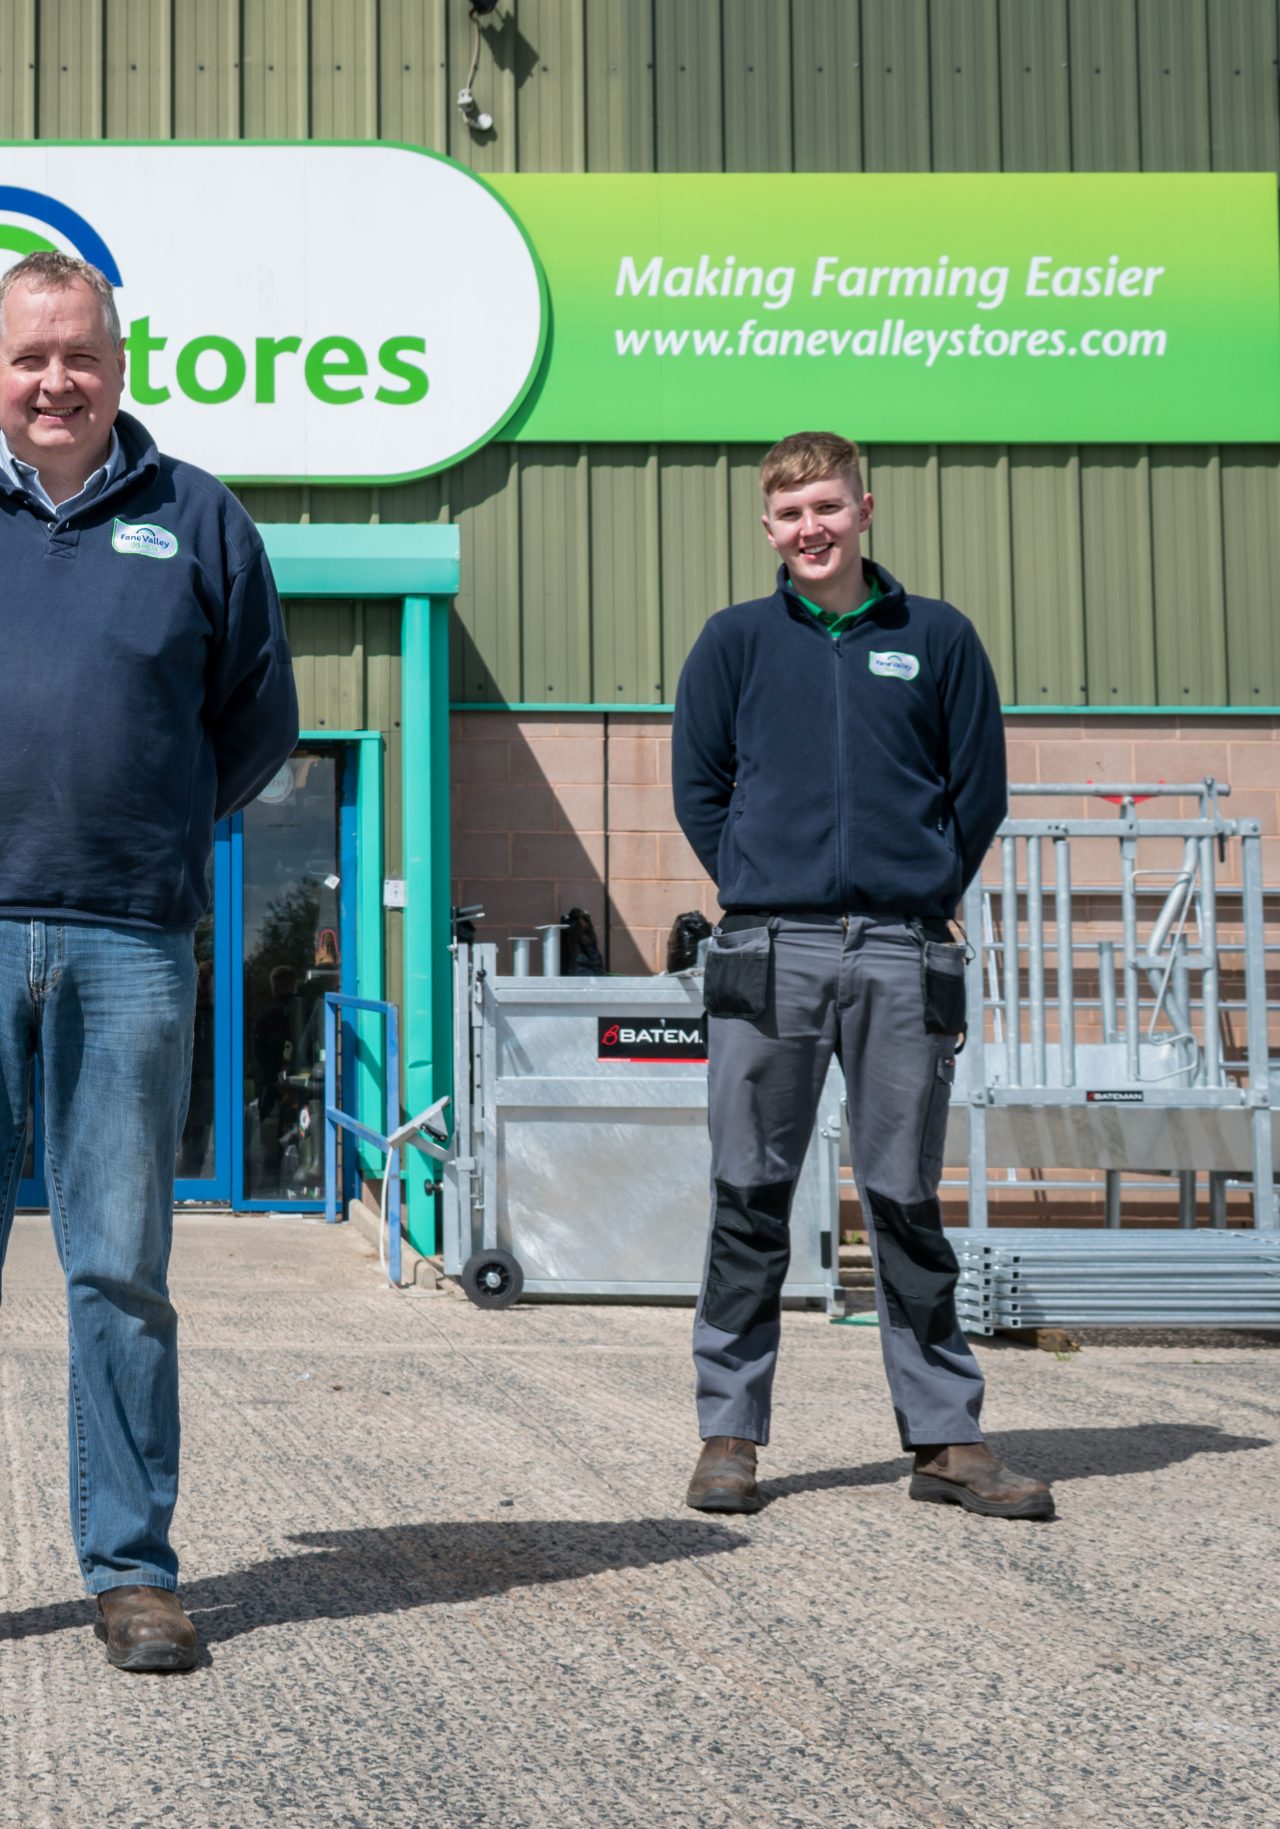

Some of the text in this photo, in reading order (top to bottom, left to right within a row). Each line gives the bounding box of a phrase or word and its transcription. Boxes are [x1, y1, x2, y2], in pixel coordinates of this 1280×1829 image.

[615, 254, 1166, 311] Making Farming Easier
[123, 315, 430, 405] tores
[614, 318, 1168, 368] www.fanevalleystores.com
[619, 1028, 703, 1044] BATEM
